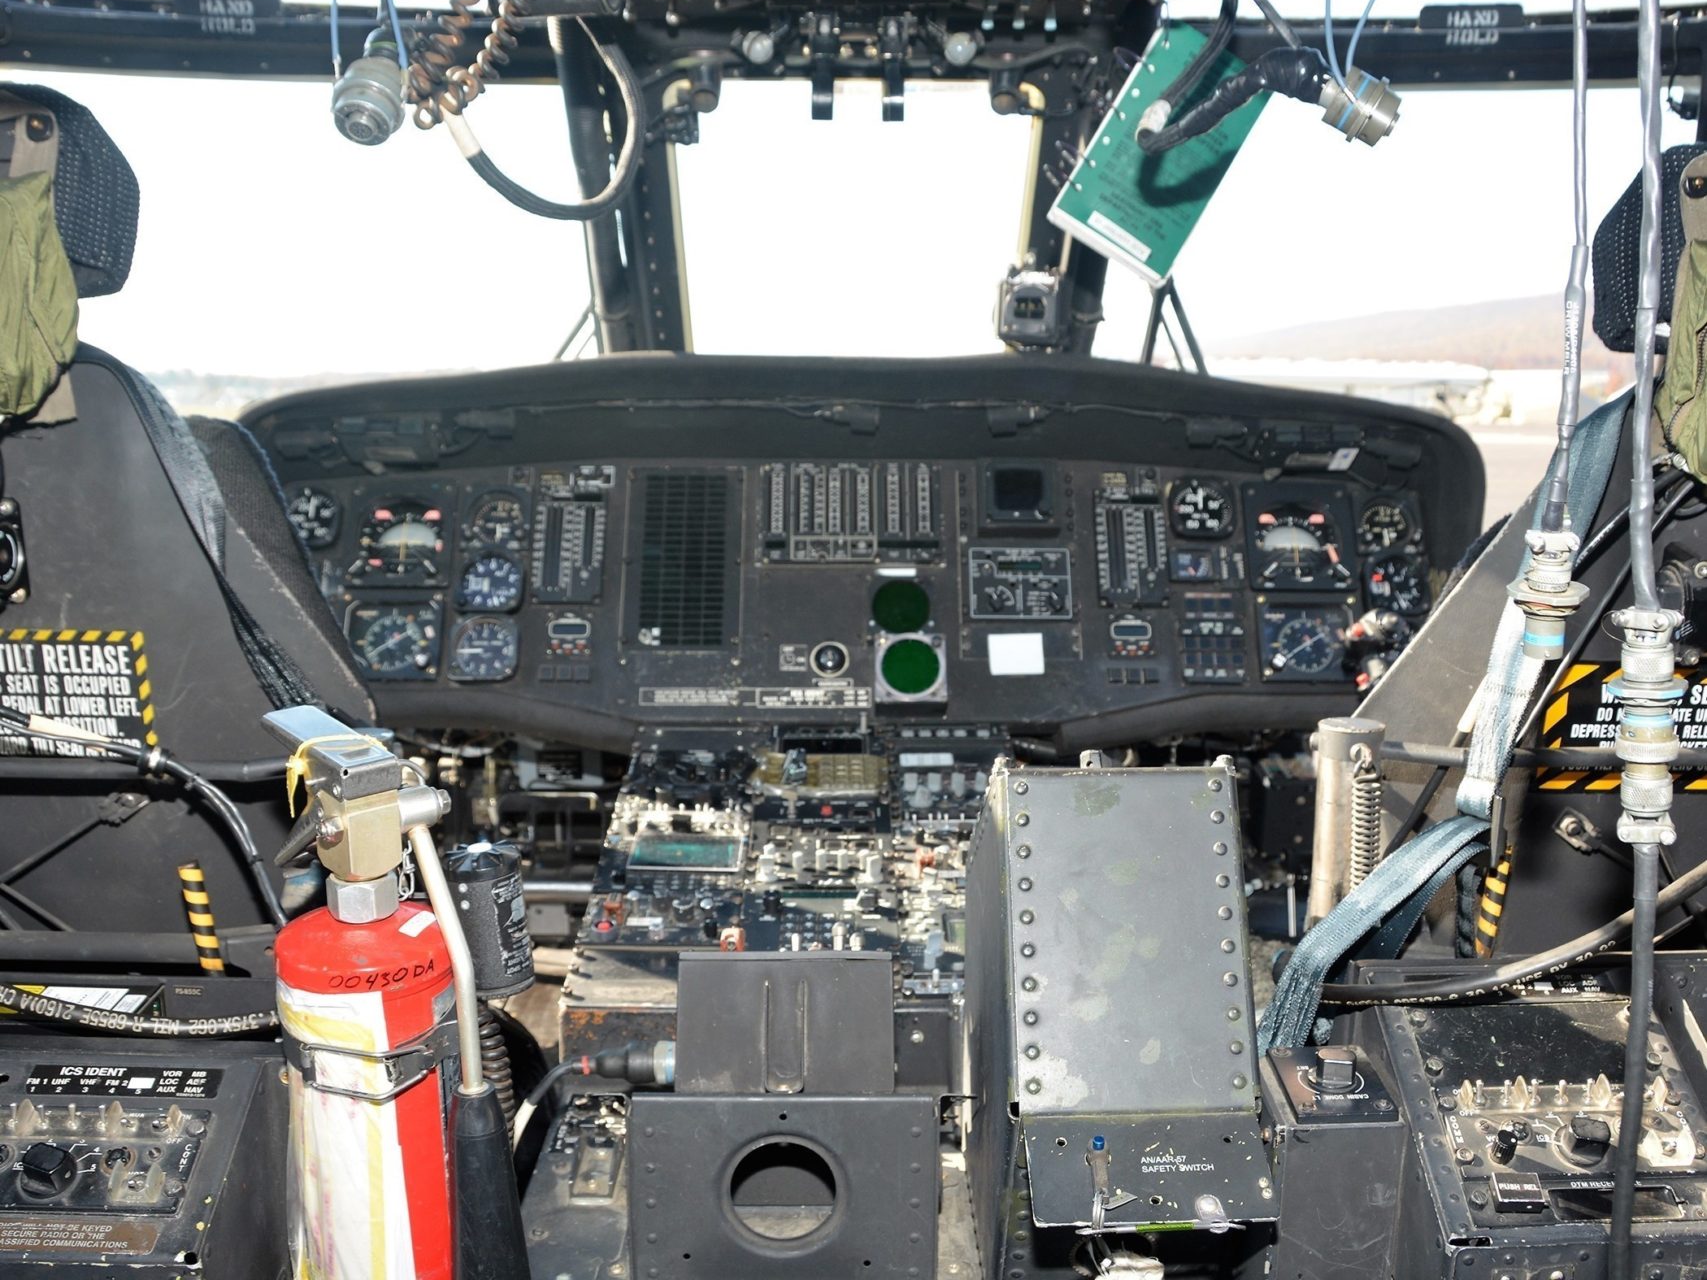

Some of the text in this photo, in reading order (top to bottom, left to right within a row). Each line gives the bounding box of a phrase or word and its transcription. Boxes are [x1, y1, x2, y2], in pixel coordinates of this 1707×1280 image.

[200, 0, 253, 15] HAND
[1447, 10, 1499, 27] HAND
[201, 16, 255, 35] HOLD
[1446, 28, 1499, 45] HOLD
[0, 644, 132, 675] TILT RELEASE
[5, 674, 131, 696] SEAT IS OCCUPIED
[2, 695, 141, 716] PEDAL AT LOWER LEFT.
[1596, 707, 1613, 721] DO
[59, 1067, 127, 1077] ICS IDENT
[162, 1070, 183, 1078] VOR
[183, 1086, 204, 1094] NAV
[1141, 1155, 1187, 1164] AN/AAR-57
[1142, 1163, 1215, 1173] SAFETY SWITCH
[1499, 1183, 1539, 1191] PUSH REL
[0, 1230, 38, 1238] SECURE
[40, 1231, 68, 1239] RADIO
[42, 1239, 128, 1248] COMMUNICATIONS
